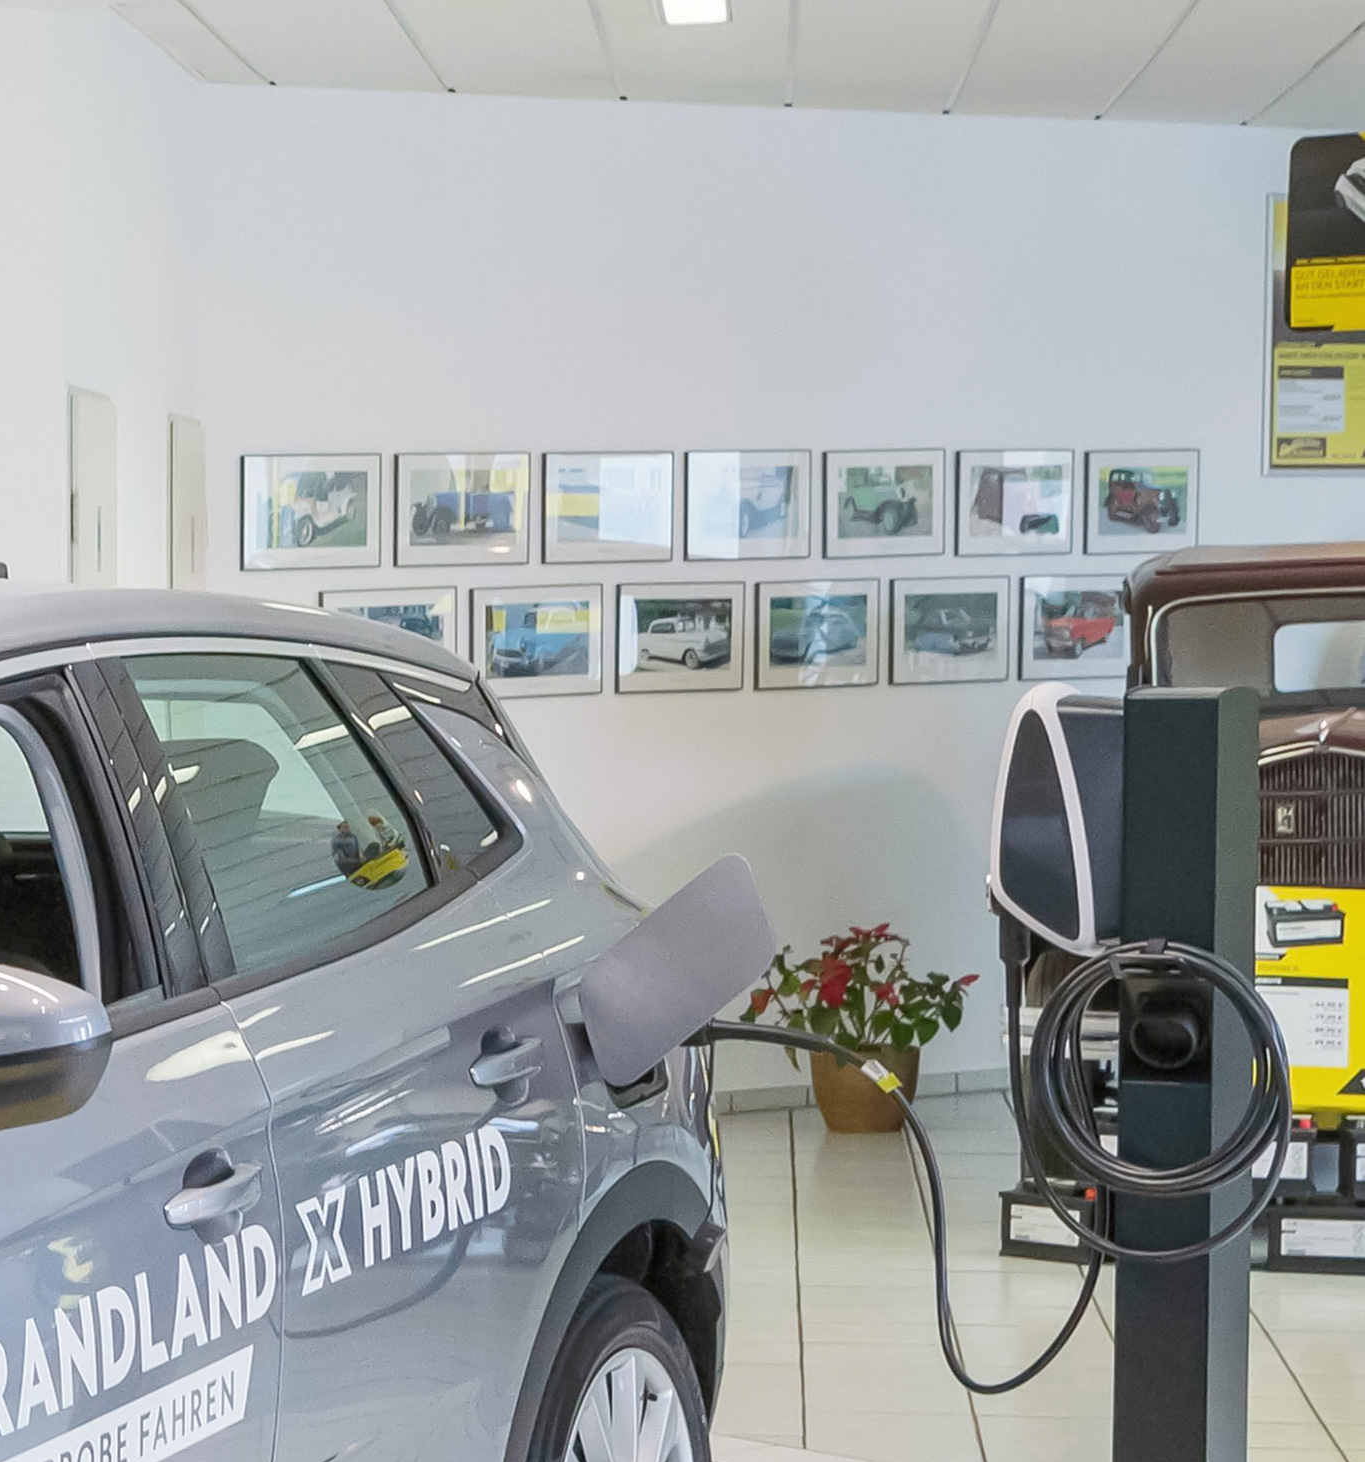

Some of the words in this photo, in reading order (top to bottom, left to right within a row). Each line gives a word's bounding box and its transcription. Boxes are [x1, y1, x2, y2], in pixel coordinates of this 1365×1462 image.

[295, 1185, 354, 1297] X
[358, 1126, 512, 1268] HYBRID
[139, 1370, 236, 1457] FAHREN
